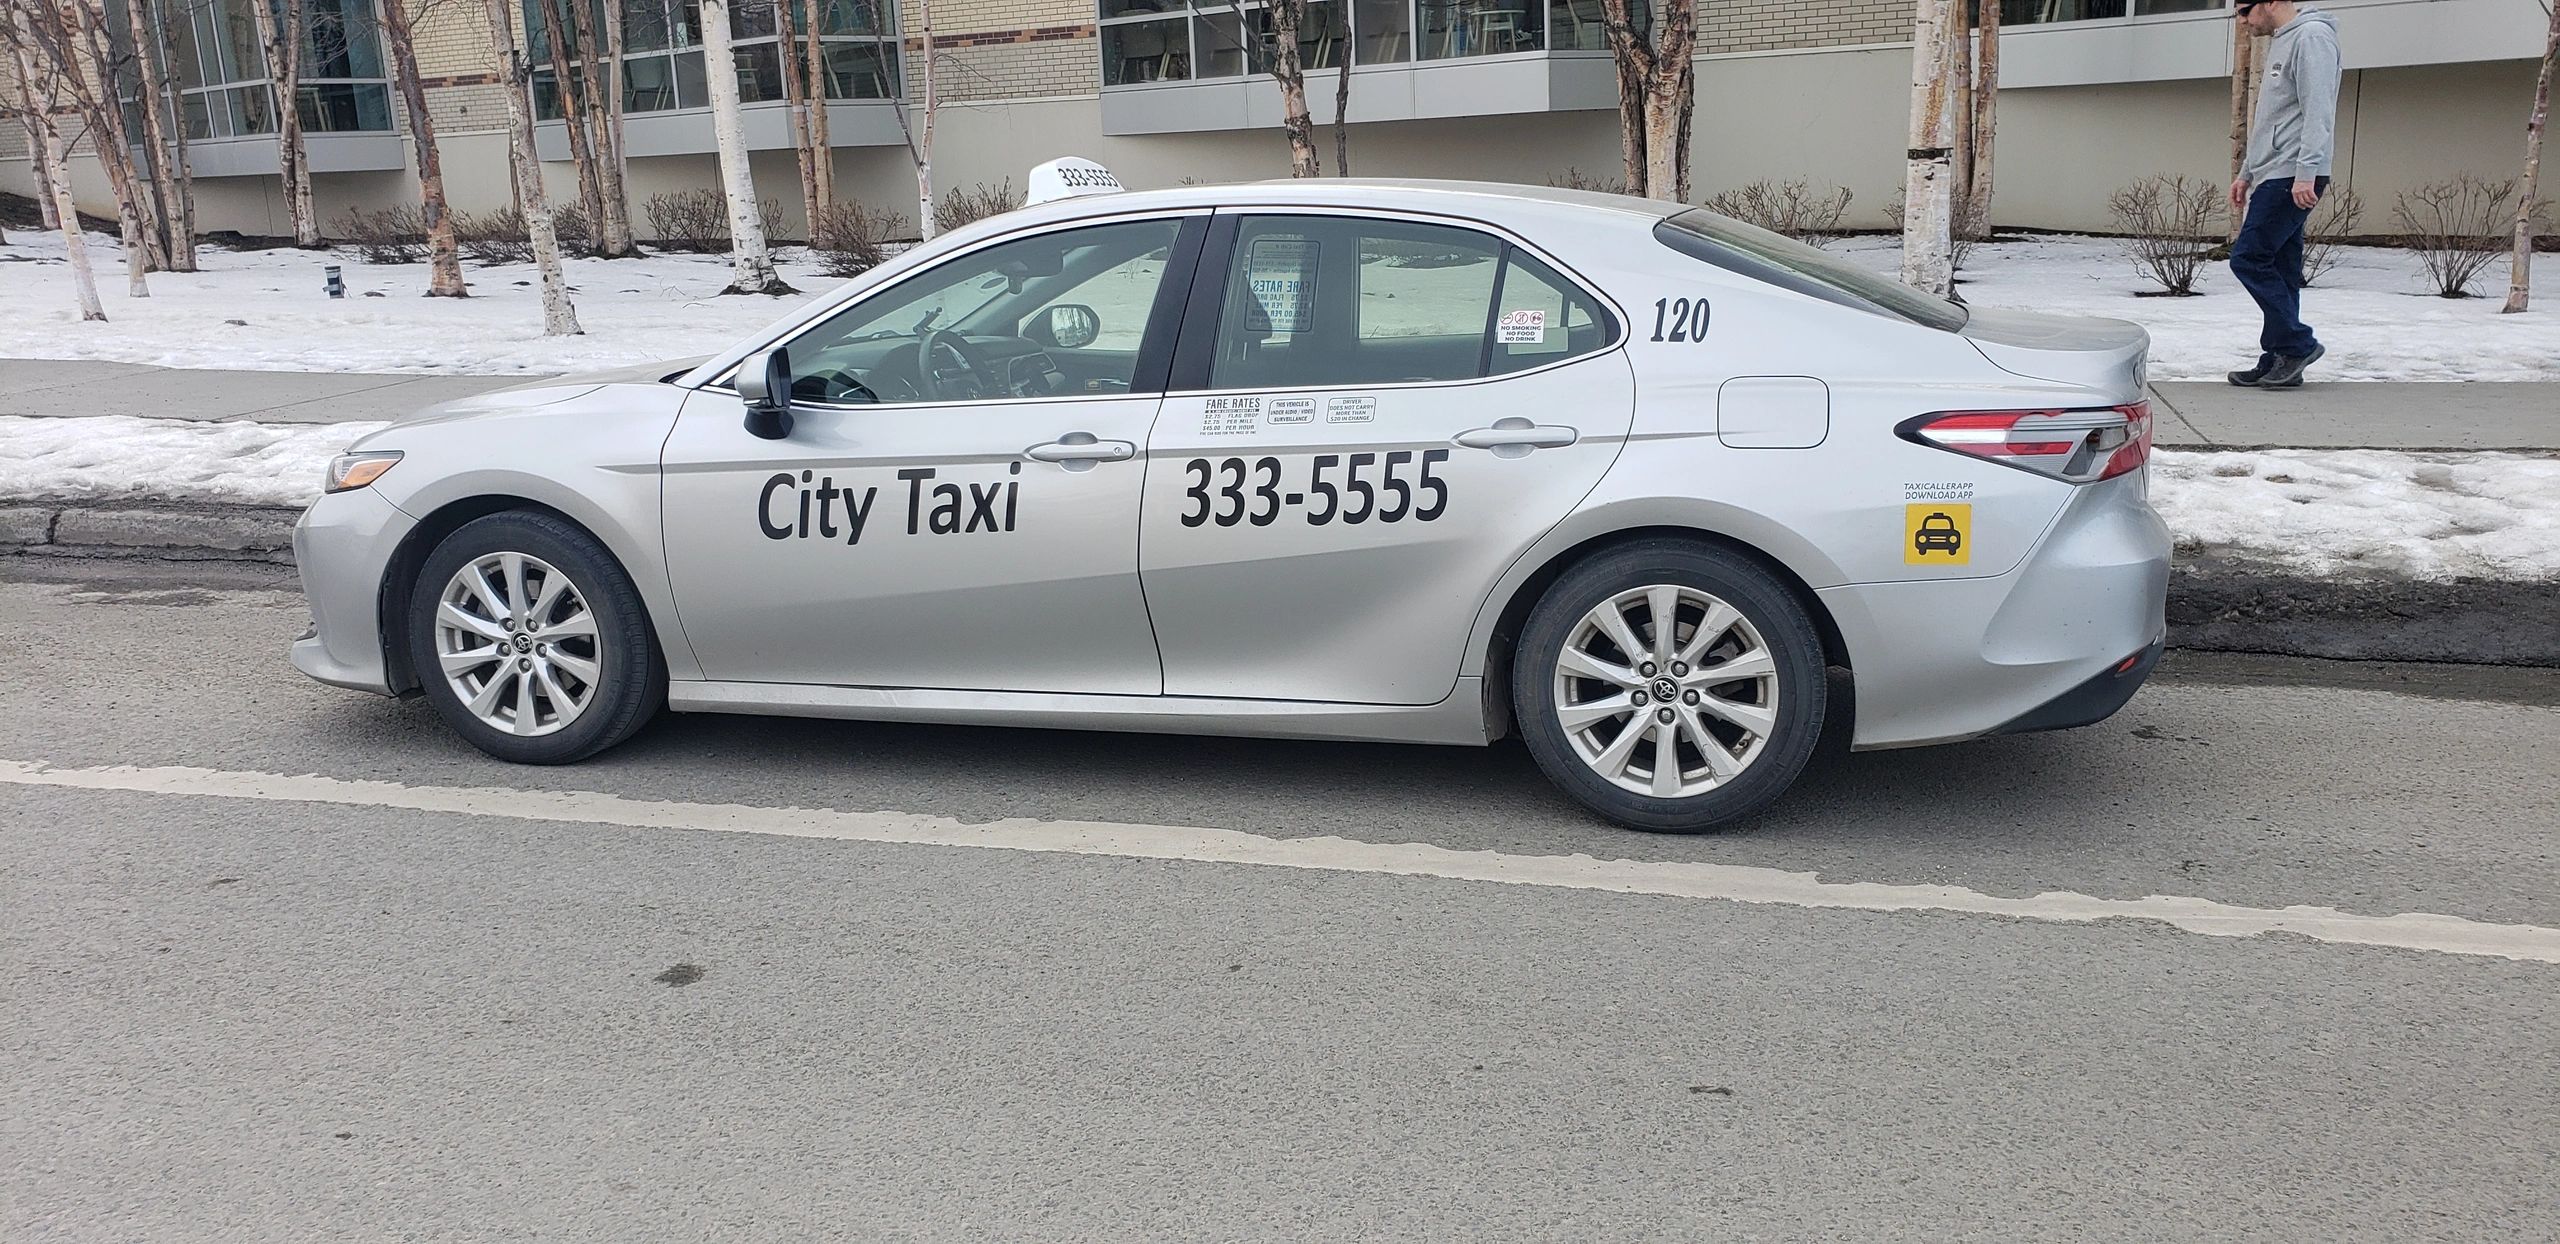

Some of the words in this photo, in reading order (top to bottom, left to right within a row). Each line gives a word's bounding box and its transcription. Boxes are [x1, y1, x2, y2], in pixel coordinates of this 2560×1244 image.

[1058, 168, 1119, 187] 333-5555
[1650, 297, 1711, 343] 120
[1206, 398, 1229, 409] FARE
[1232, 397, 1261, 409] RATES
[758, 469, 877, 545] City
[897, 461, 1022, 535] Taxi
[1181, 449, 1449, 527] 333-5555
[1905, 491, 1956, 500] DOWNLOAD
[1957, 491, 1974, 499] APP
